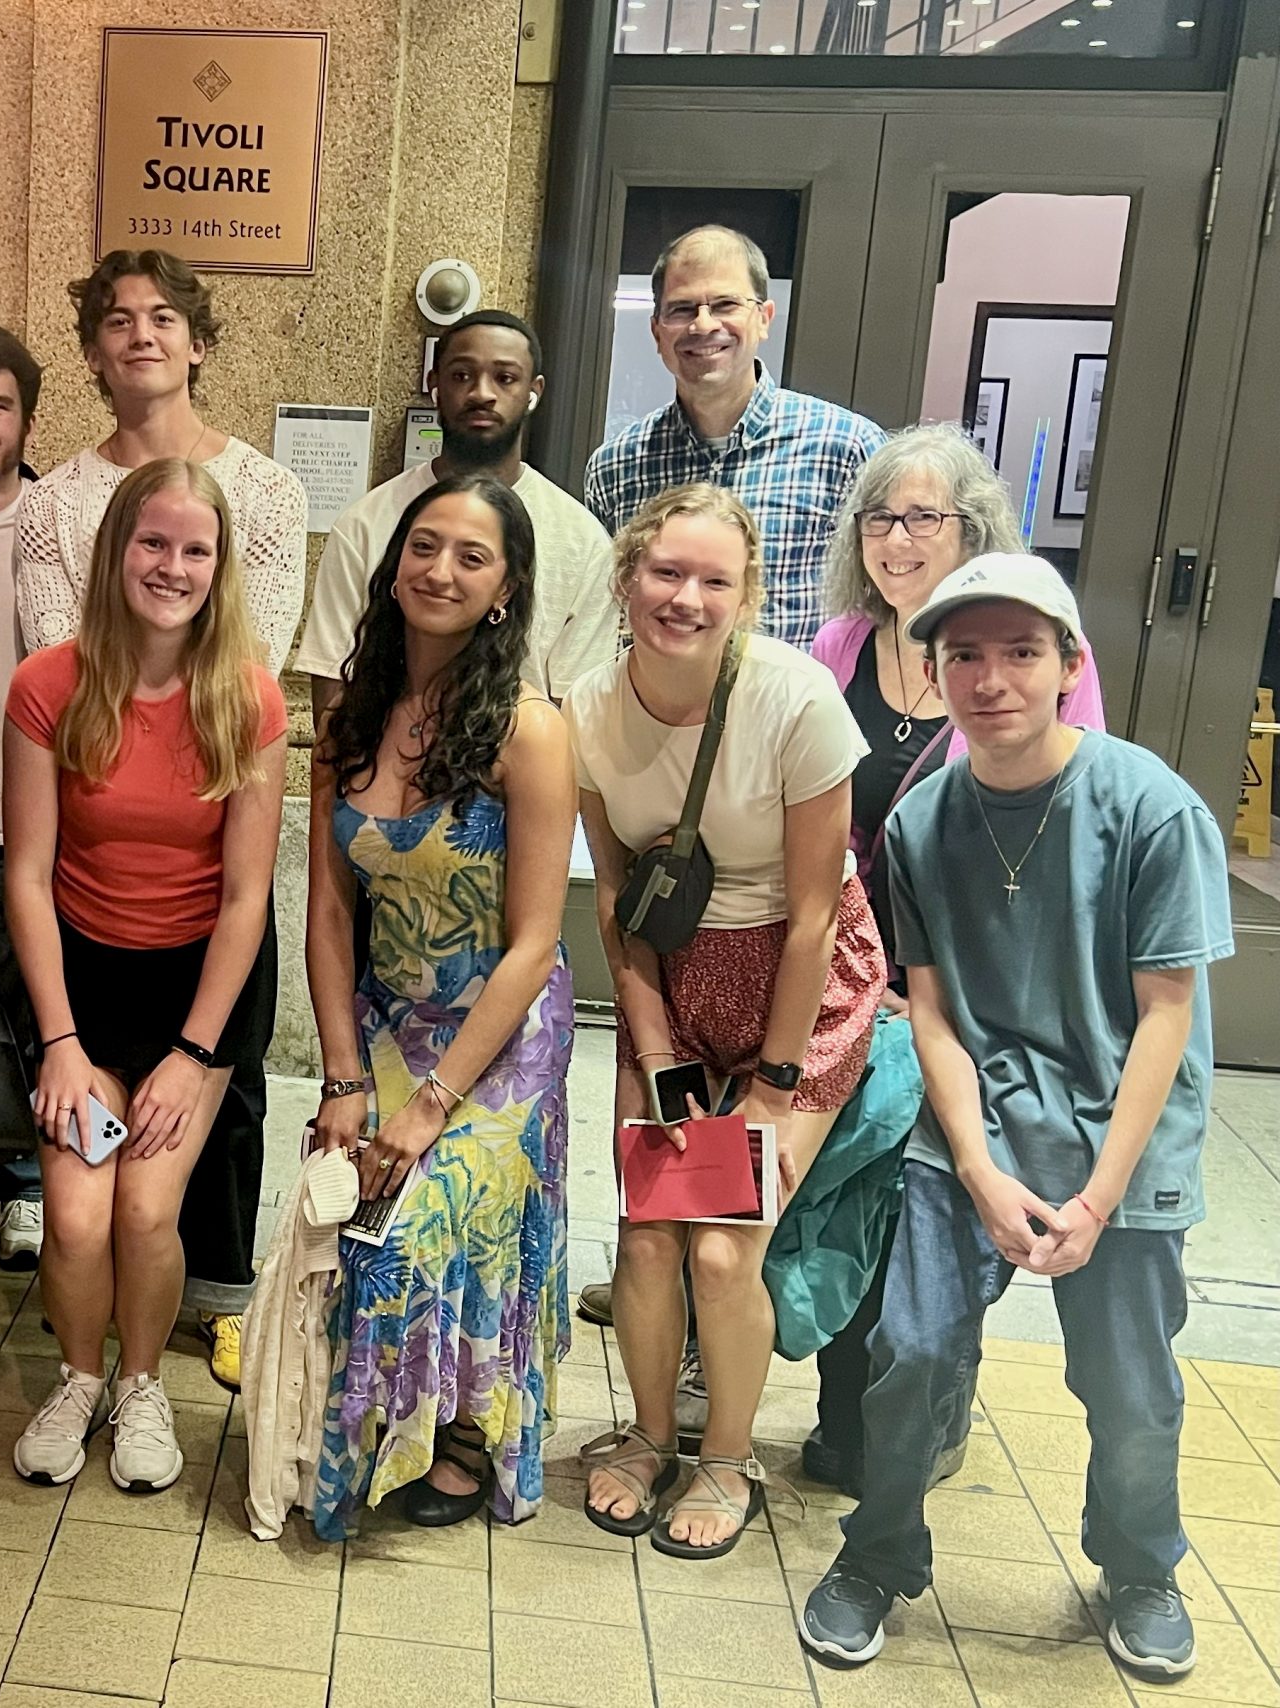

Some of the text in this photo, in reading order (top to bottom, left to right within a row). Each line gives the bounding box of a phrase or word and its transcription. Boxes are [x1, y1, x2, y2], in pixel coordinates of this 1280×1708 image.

[156, 116, 264, 150] TIVOLI
[143, 159, 271, 194] SQUARE
[128, 217, 282, 239] 3333 14th Street
[310, 432, 324, 440] ALL
[292, 441, 335, 449] DELIVERIES
[291, 458, 358, 467] PUBLIC CHARTER
[325, 468, 354, 476] PLEASE
[308, 503, 340, 511] UILDING
